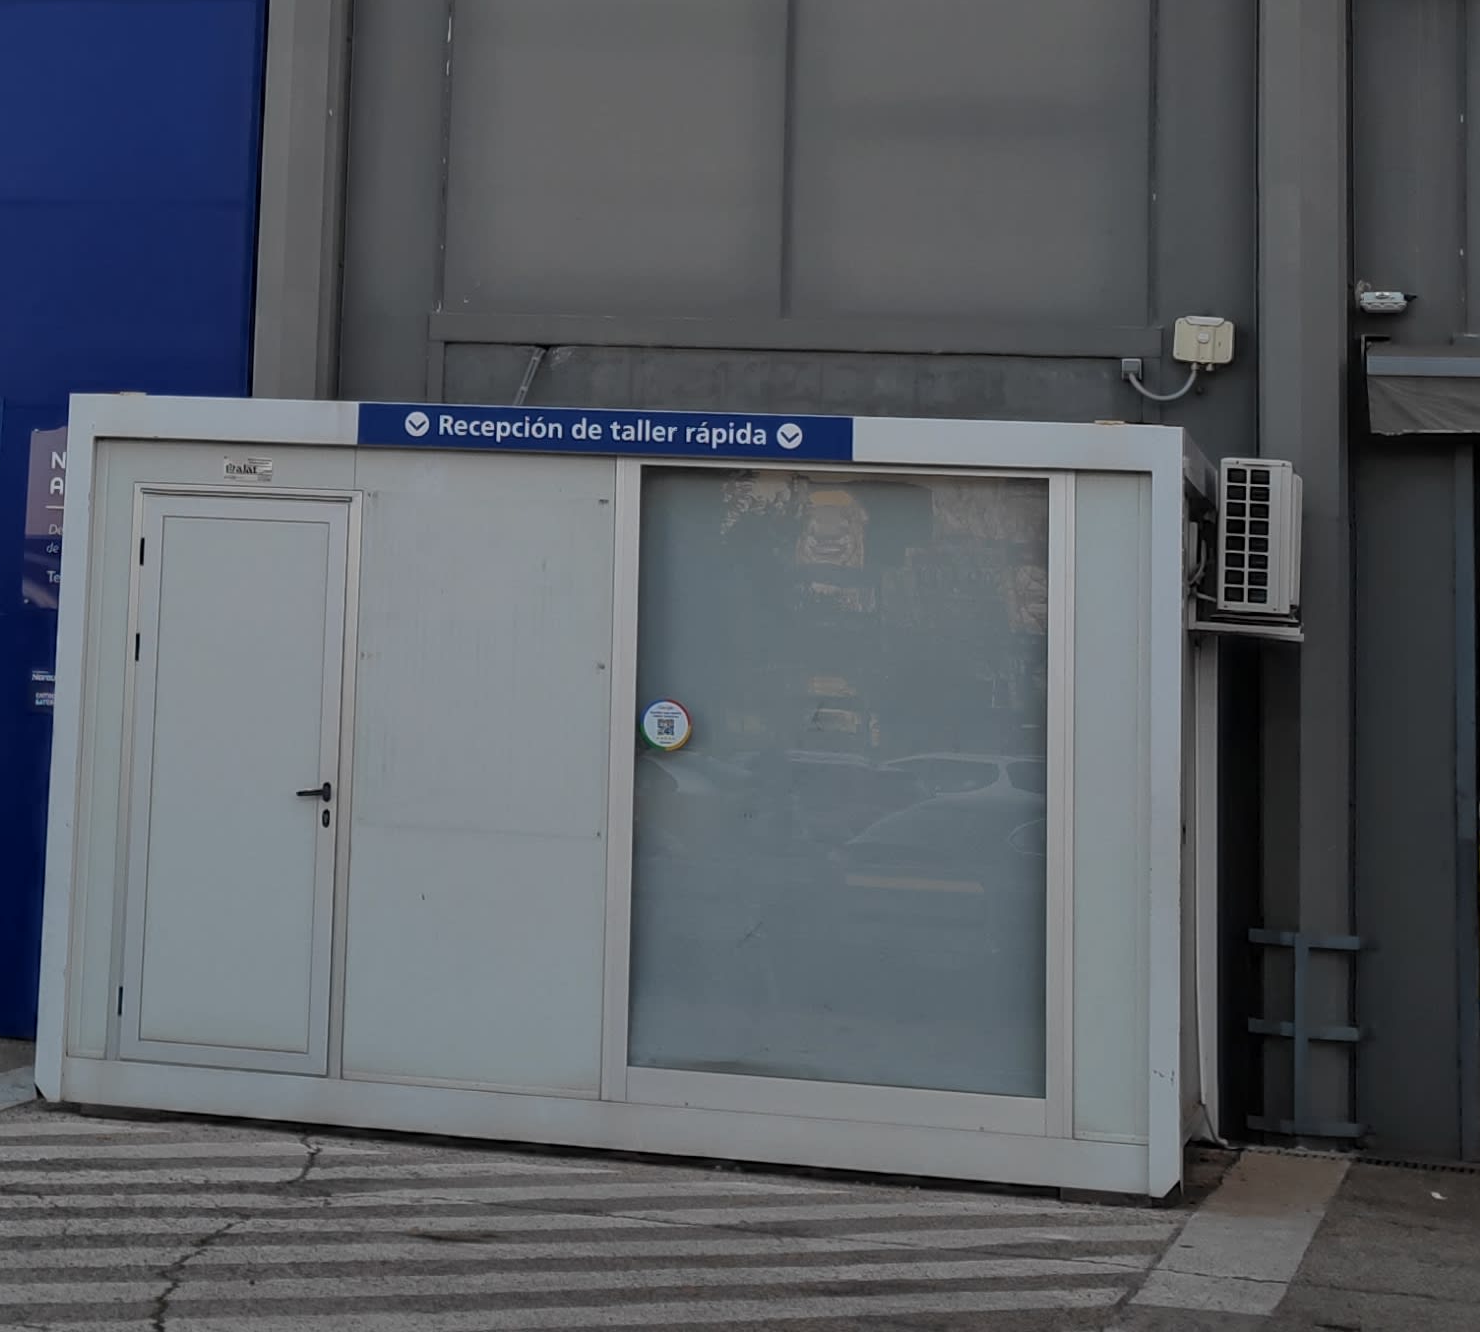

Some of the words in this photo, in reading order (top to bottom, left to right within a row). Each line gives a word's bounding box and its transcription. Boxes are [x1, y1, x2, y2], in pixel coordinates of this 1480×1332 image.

[439, 414, 564, 443] Recepción
[571, 417, 602, 441] de
[610, 419, 677, 444] taller
[685, 422, 767, 446] rápida
